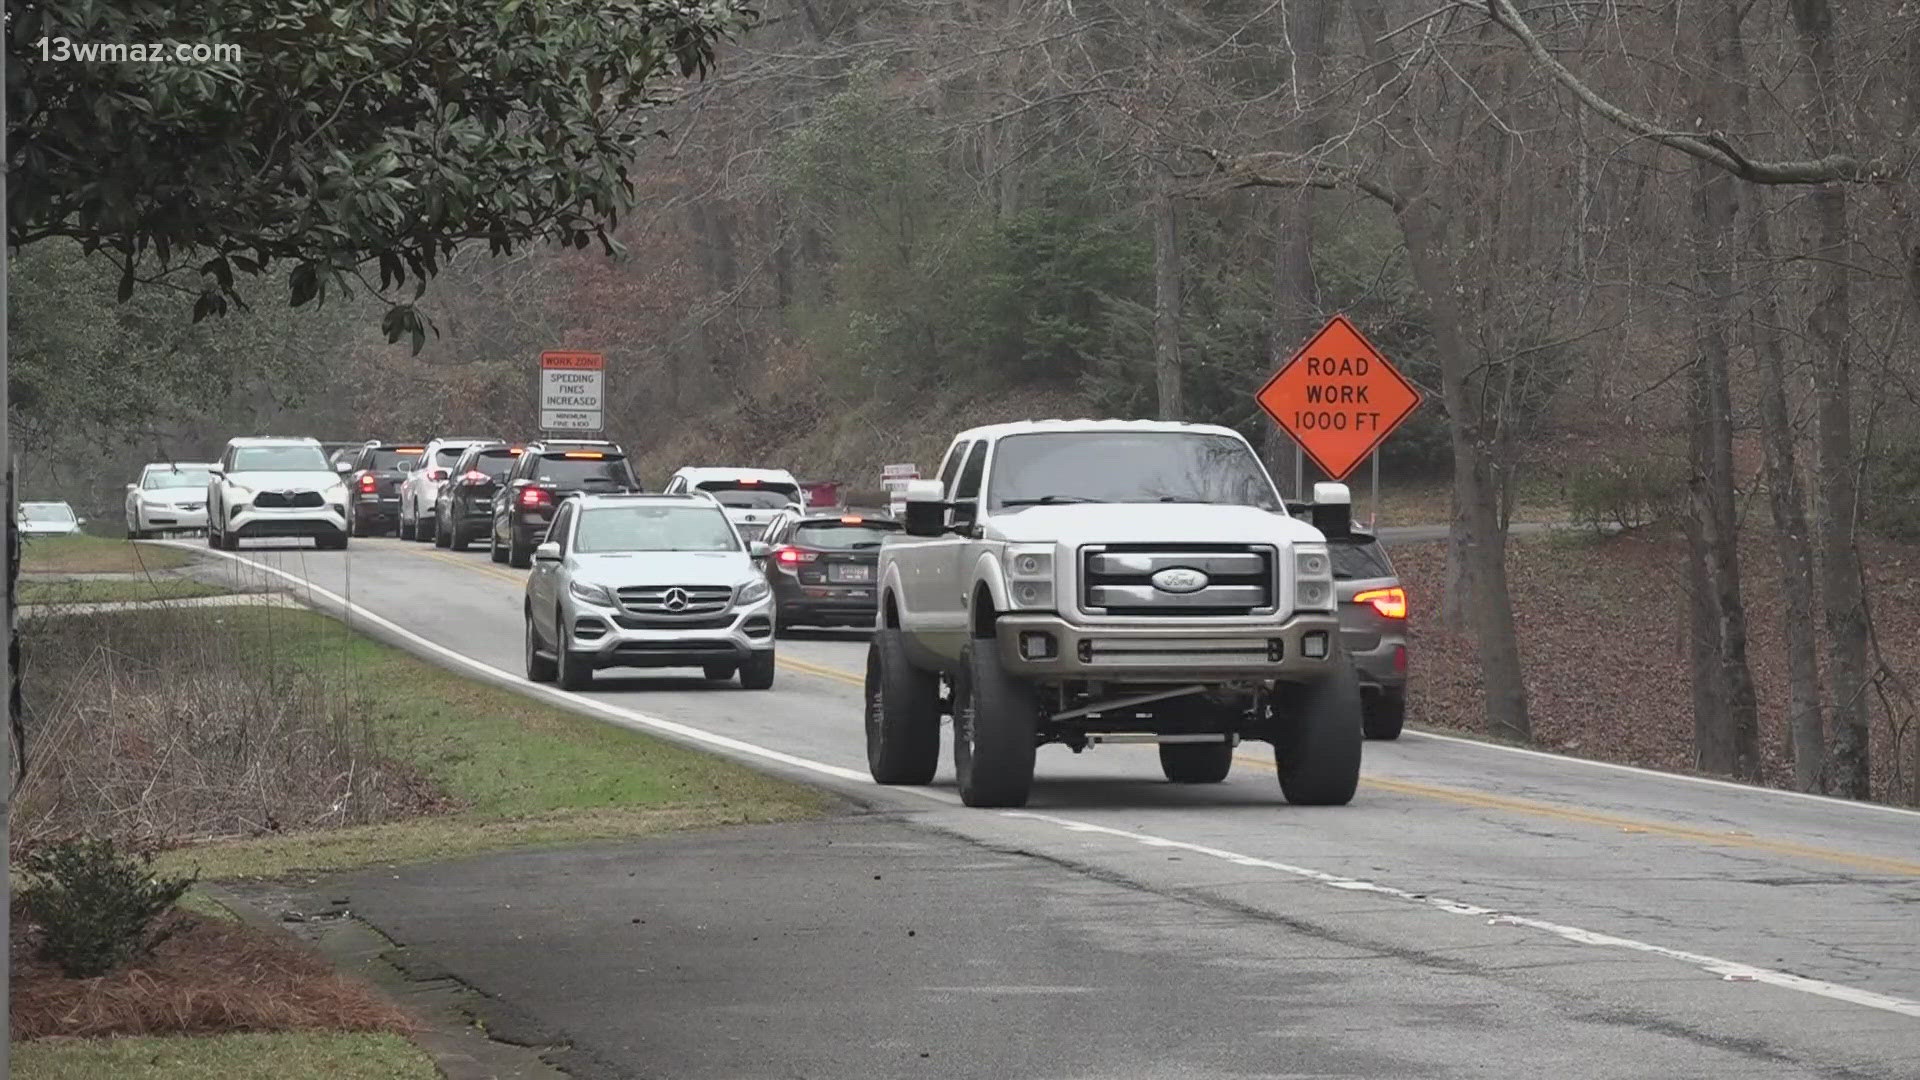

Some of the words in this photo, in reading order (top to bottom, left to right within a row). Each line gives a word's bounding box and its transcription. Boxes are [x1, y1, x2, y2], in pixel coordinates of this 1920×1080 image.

[546, 357, 571, 366] WORK
[1307, 357, 1369, 376] ROAD
[550, 373, 594, 383] SPEEDING
[559, 385, 584, 394] FINES
[1306, 385, 1369, 404] WORK
[547, 396, 597, 405] INCREASED
[1295, 411, 1347, 430] 1000
[1355, 412, 1380, 431] FT
